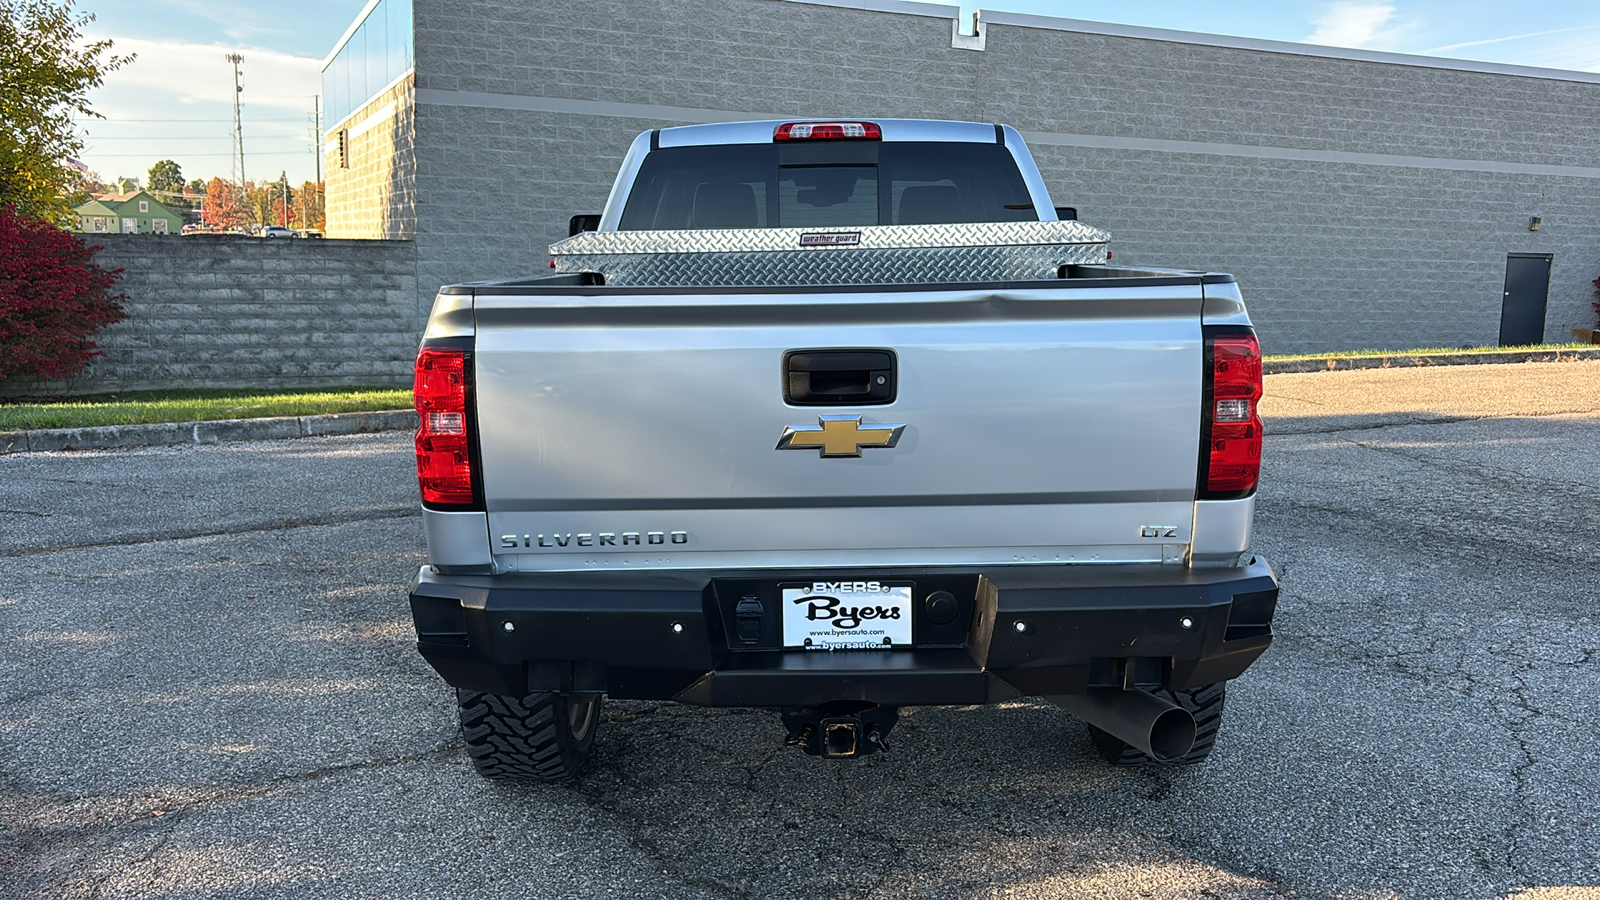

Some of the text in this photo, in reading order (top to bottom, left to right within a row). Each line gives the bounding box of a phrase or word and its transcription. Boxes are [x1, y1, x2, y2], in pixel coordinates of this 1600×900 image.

[1140, 525, 1177, 538] LTZ
[501, 530, 688, 548] SILVERADO
[812, 581, 881, 594] BYERS
[793, 595, 901, 629] Byers
[809, 629, 885, 637] www.byersauto.com
[805, 640, 892, 651] www.byersauto.com
